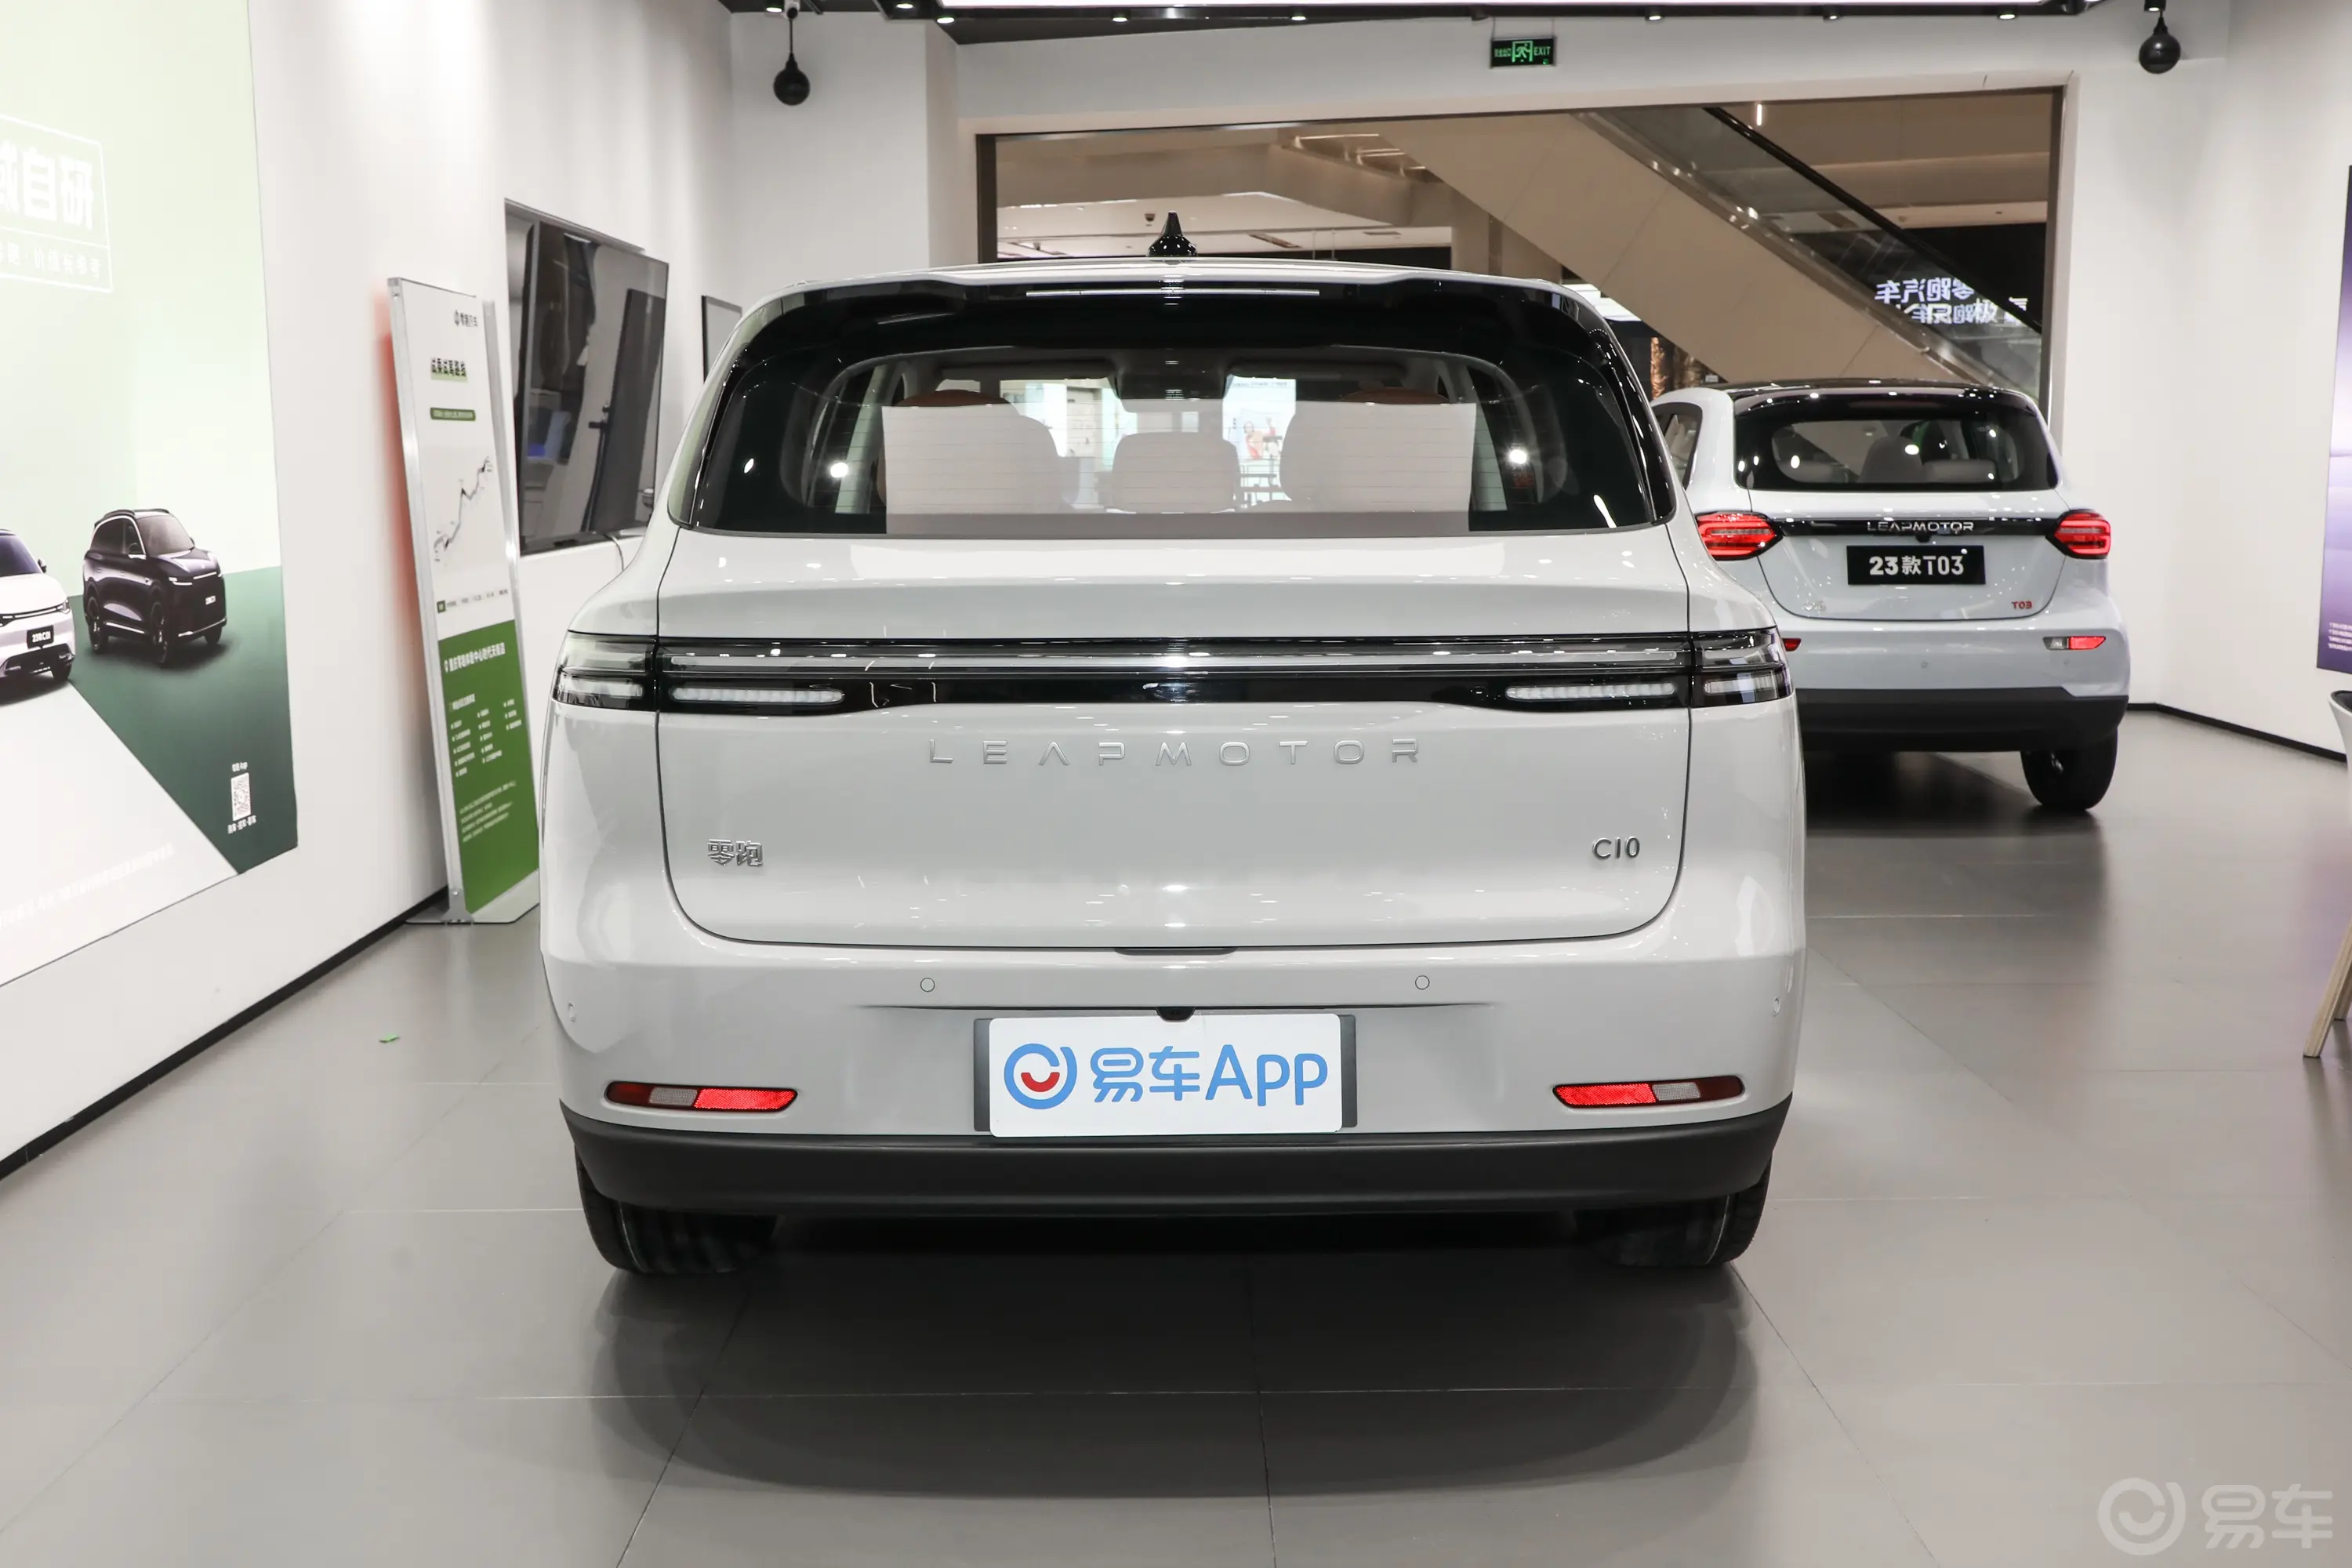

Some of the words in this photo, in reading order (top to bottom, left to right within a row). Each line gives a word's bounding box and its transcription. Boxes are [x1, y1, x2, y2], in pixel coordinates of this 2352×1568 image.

[1534, 46, 1551, 56] EXIT
[1867, 521, 1974, 532] LEAPMOTOR
[1869, 555, 1965, 575] 23款T03
[929, 738, 1420, 766] LEAPMOTOR
[706, 839, 764, 867] 零跑
[1592, 836, 1641, 860] C10
[1091, 1044, 1328, 1106] 易车App
